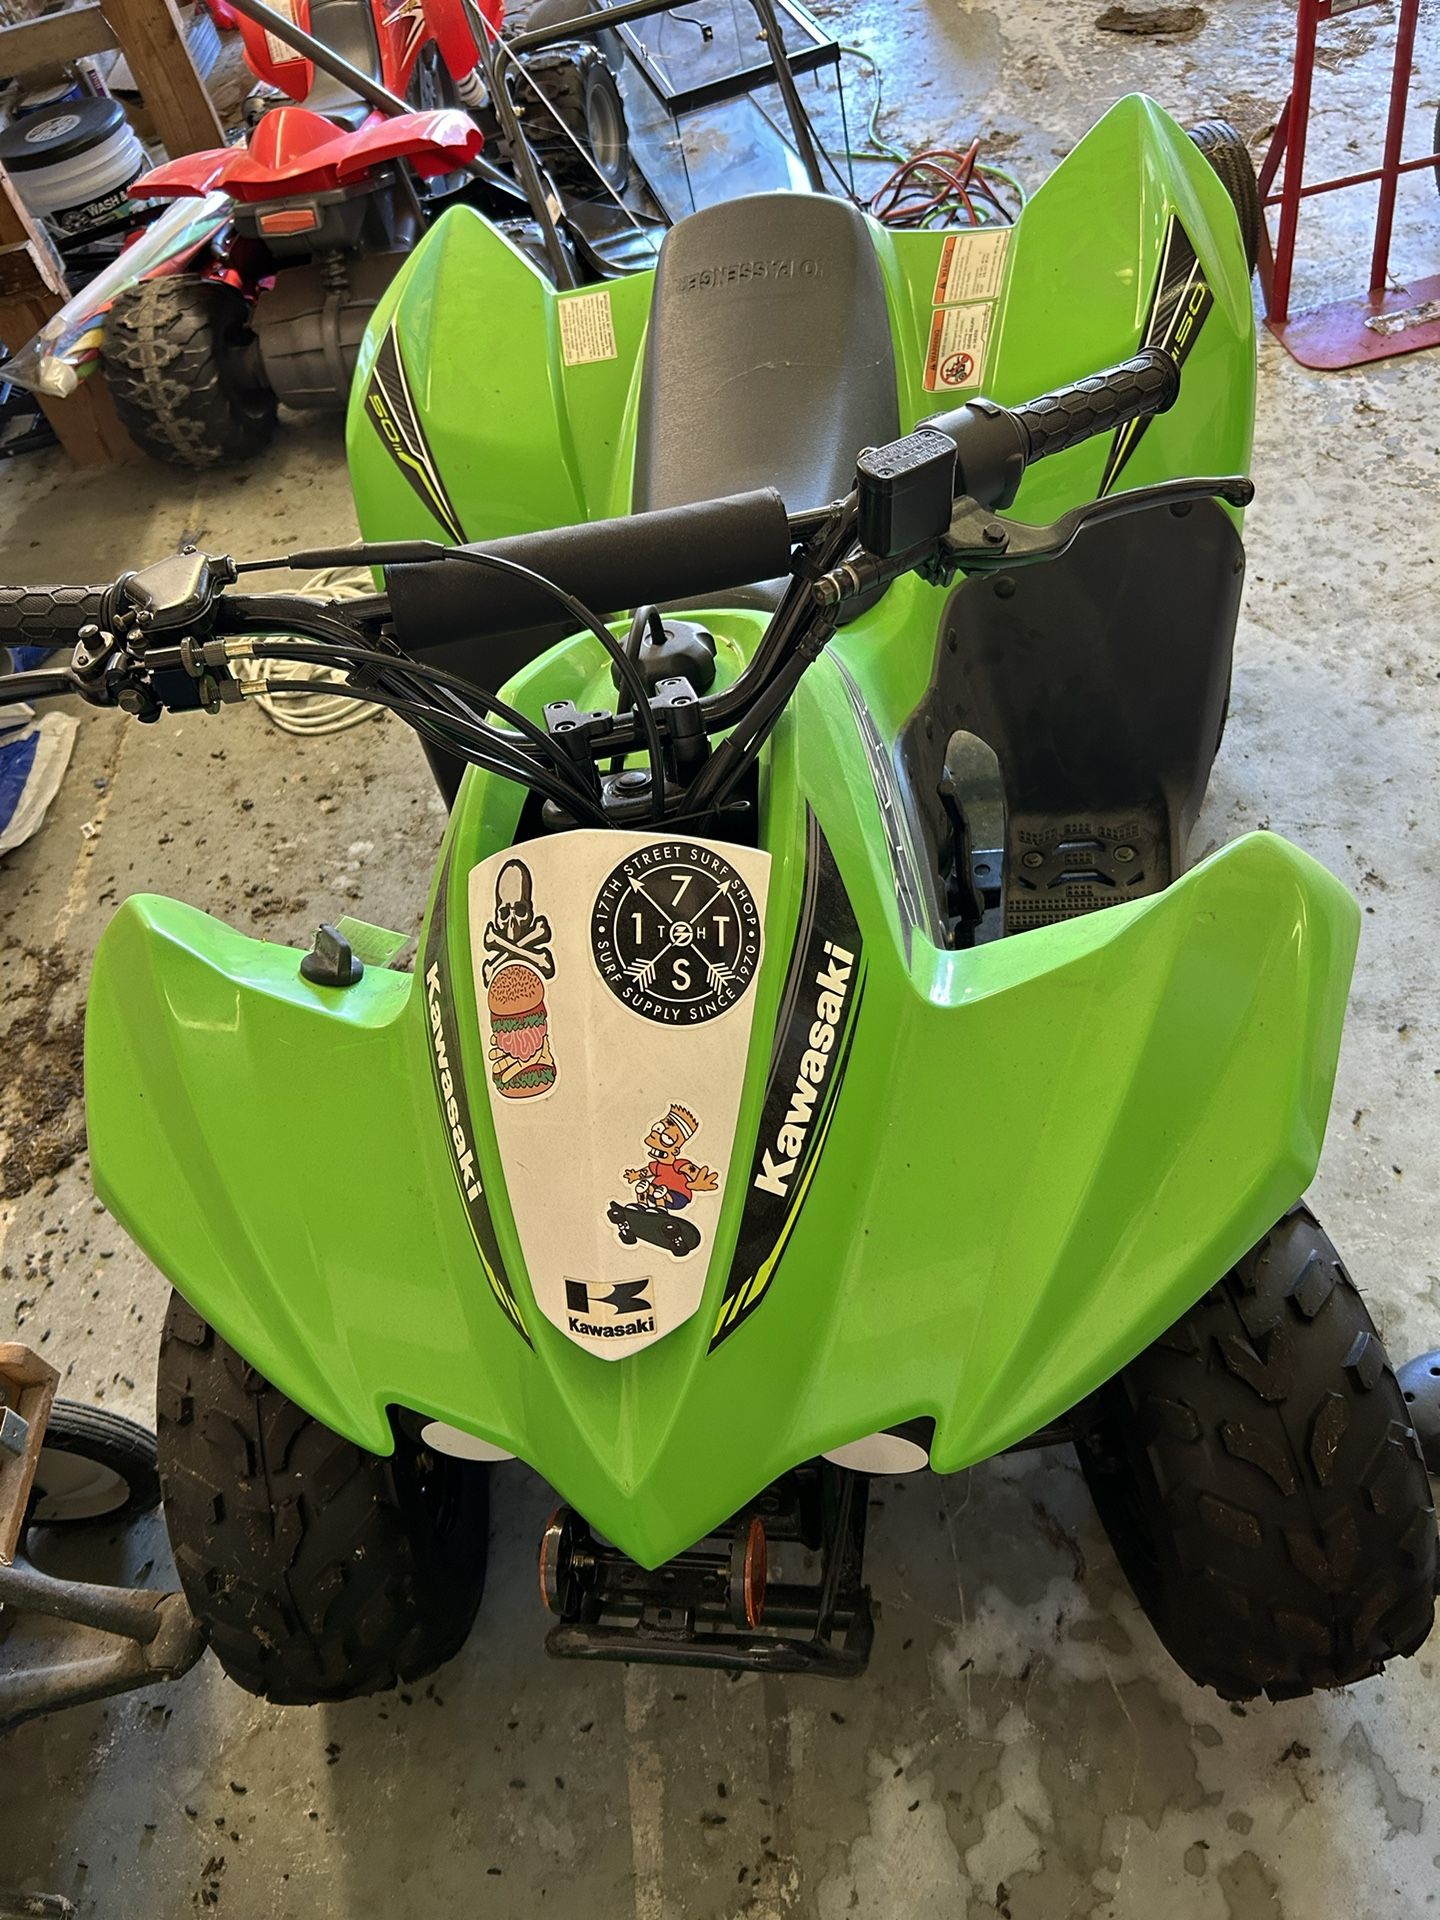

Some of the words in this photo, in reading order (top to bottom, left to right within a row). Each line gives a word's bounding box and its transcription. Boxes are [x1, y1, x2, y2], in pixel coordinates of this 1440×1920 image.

[87, 194, 120, 217] WASH
[674, 260, 795, 292] PASSENGER
[596, 878, 622, 919] 17TH
[623, 846, 681, 876] STREET
[690, 848, 729, 875] SURF
[731, 879, 757, 925] SHOP
[670, 874, 693, 907] 7
[597, 940, 623, 983] SURF
[622, 986, 681, 1021] SUPPLY
[689, 987, 736, 1020] SINCE
[735, 944, 756, 984] 1970
[671, 958, 691, 991] S
[426, 961, 483, 1203] Kawasaki
[753, 940, 855, 1198] Kawasaki
[568, 1316, 655, 1338] Kawasaki
